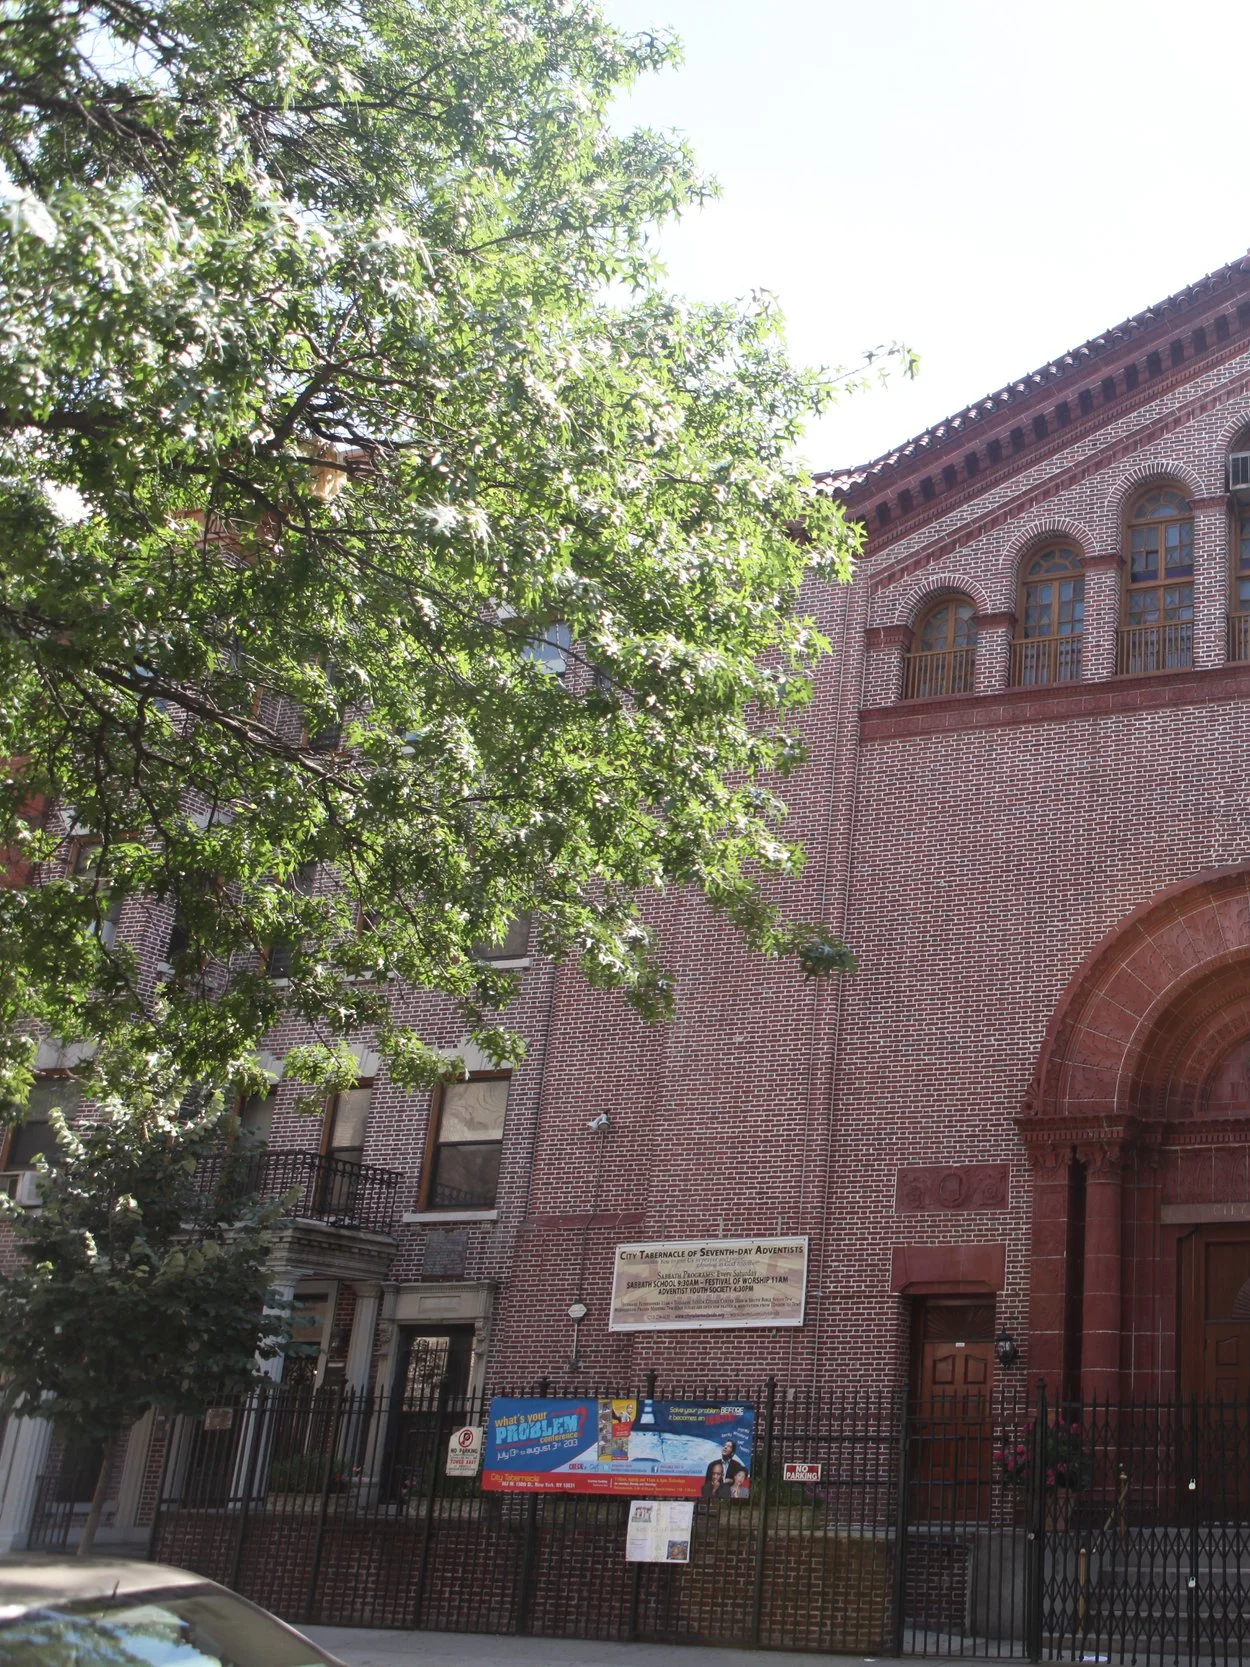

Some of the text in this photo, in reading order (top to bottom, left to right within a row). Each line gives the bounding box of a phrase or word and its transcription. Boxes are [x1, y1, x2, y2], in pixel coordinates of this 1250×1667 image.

[626, 1280, 652, 1289] SABBATH
[653, 1280, 676, 1288] SCHOOL
[677, 1279, 699, 1287] 9:30AM
[705, 1278, 731, 1286] FESTIVAL
[733, 1277, 741, 1285] OF
[742, 1276, 770, 1285] WORSHIP
[771, 1275, 789, 1283] 11AM
[658, 1284, 754, 1295] ADVENTIST YOUTH SOCIETY 4:30PM
[495, 1411, 548, 1427] what's your
[539, 1432, 578, 1444] conference
[526, 1445, 551, 1455] august
[796, 1465, 809, 1473] NO
[786, 1472, 817, 1480] PARKING
